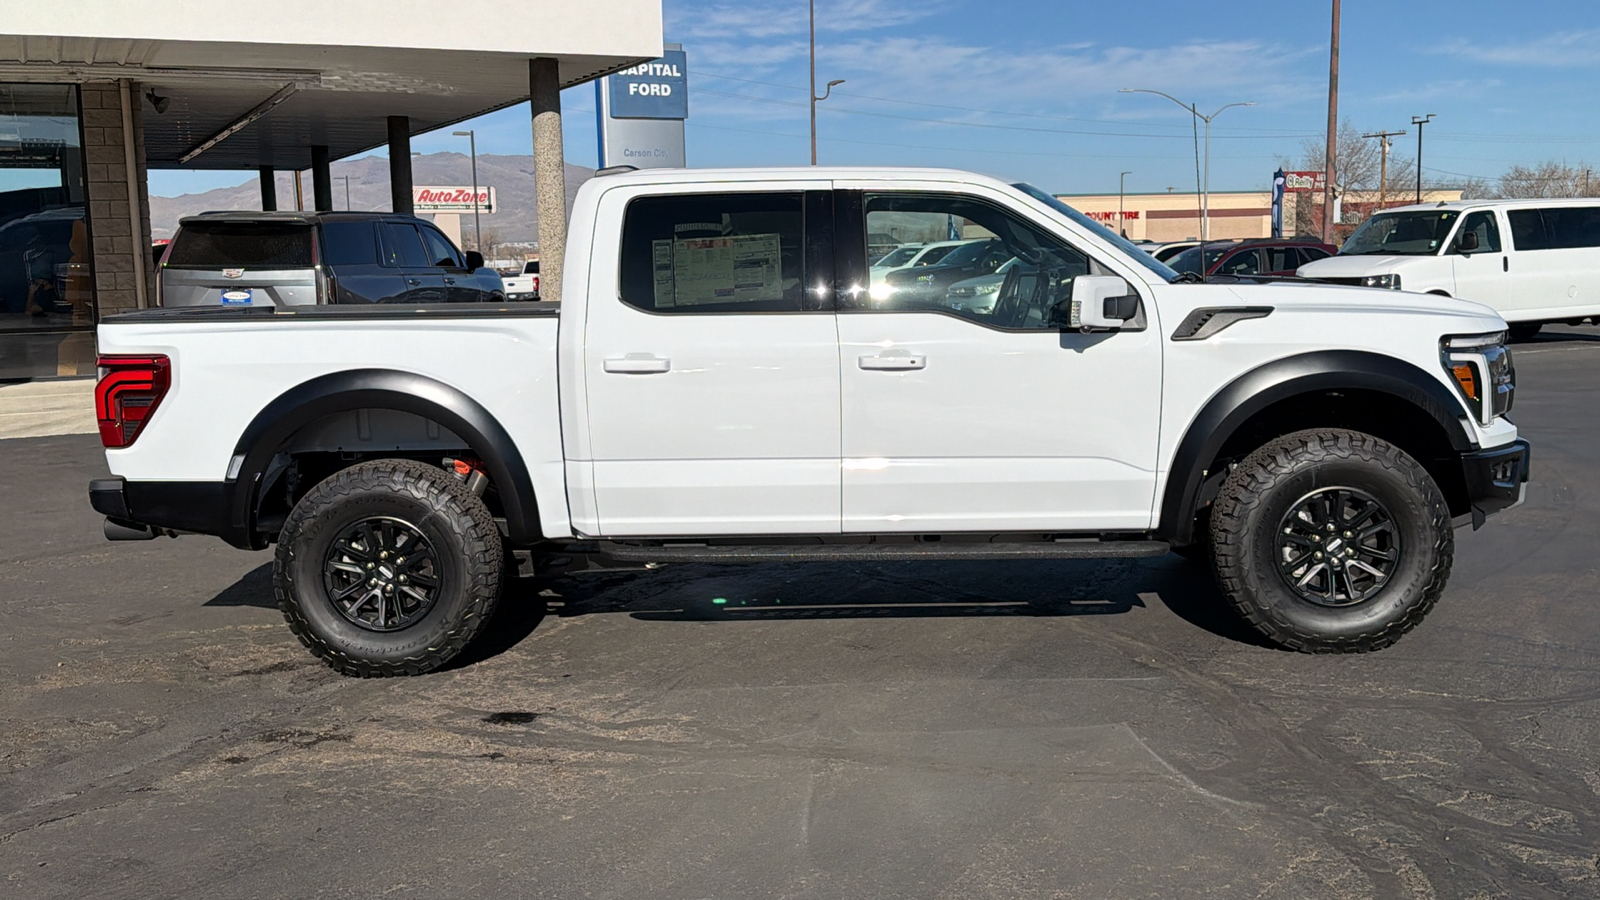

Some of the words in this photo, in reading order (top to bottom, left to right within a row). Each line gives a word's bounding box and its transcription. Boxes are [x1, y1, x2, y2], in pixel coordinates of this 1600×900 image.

[629, 83, 672, 96] FORD
[623, 148, 652, 158] Carson
[418, 189, 488, 203] AutoZone
[1118, 211, 1139, 220] TIRE
